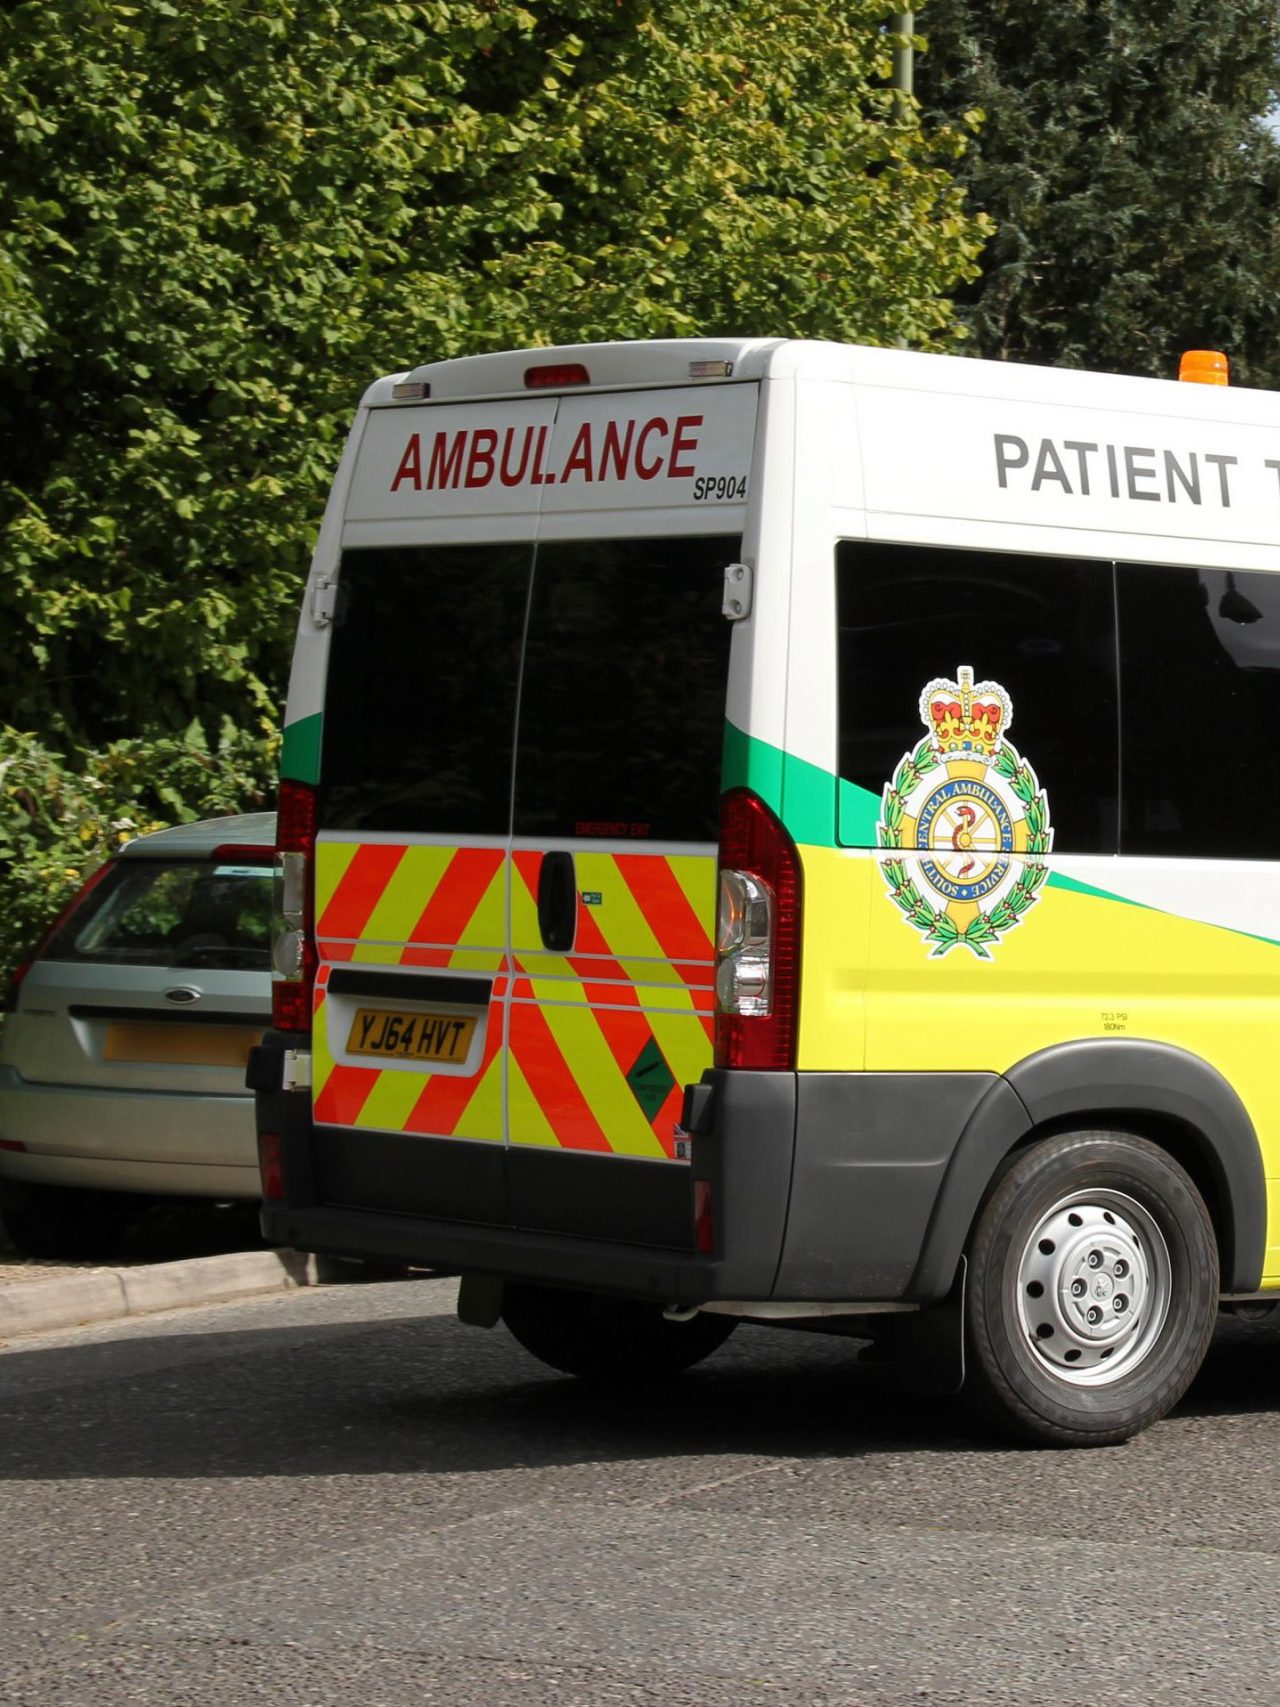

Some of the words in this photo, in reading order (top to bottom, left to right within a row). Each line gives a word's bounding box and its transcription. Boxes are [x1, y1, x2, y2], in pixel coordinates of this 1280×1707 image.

[390, 415, 703, 491] AMBULANCE
[994, 433, 1238, 508] PATIENT
[693, 475, 747, 500] SP904
[952, 783, 1012, 843] AMBULANCE
[360, 1014, 416, 1052] YJ64
[417, 1019, 466, 1056] HVT
